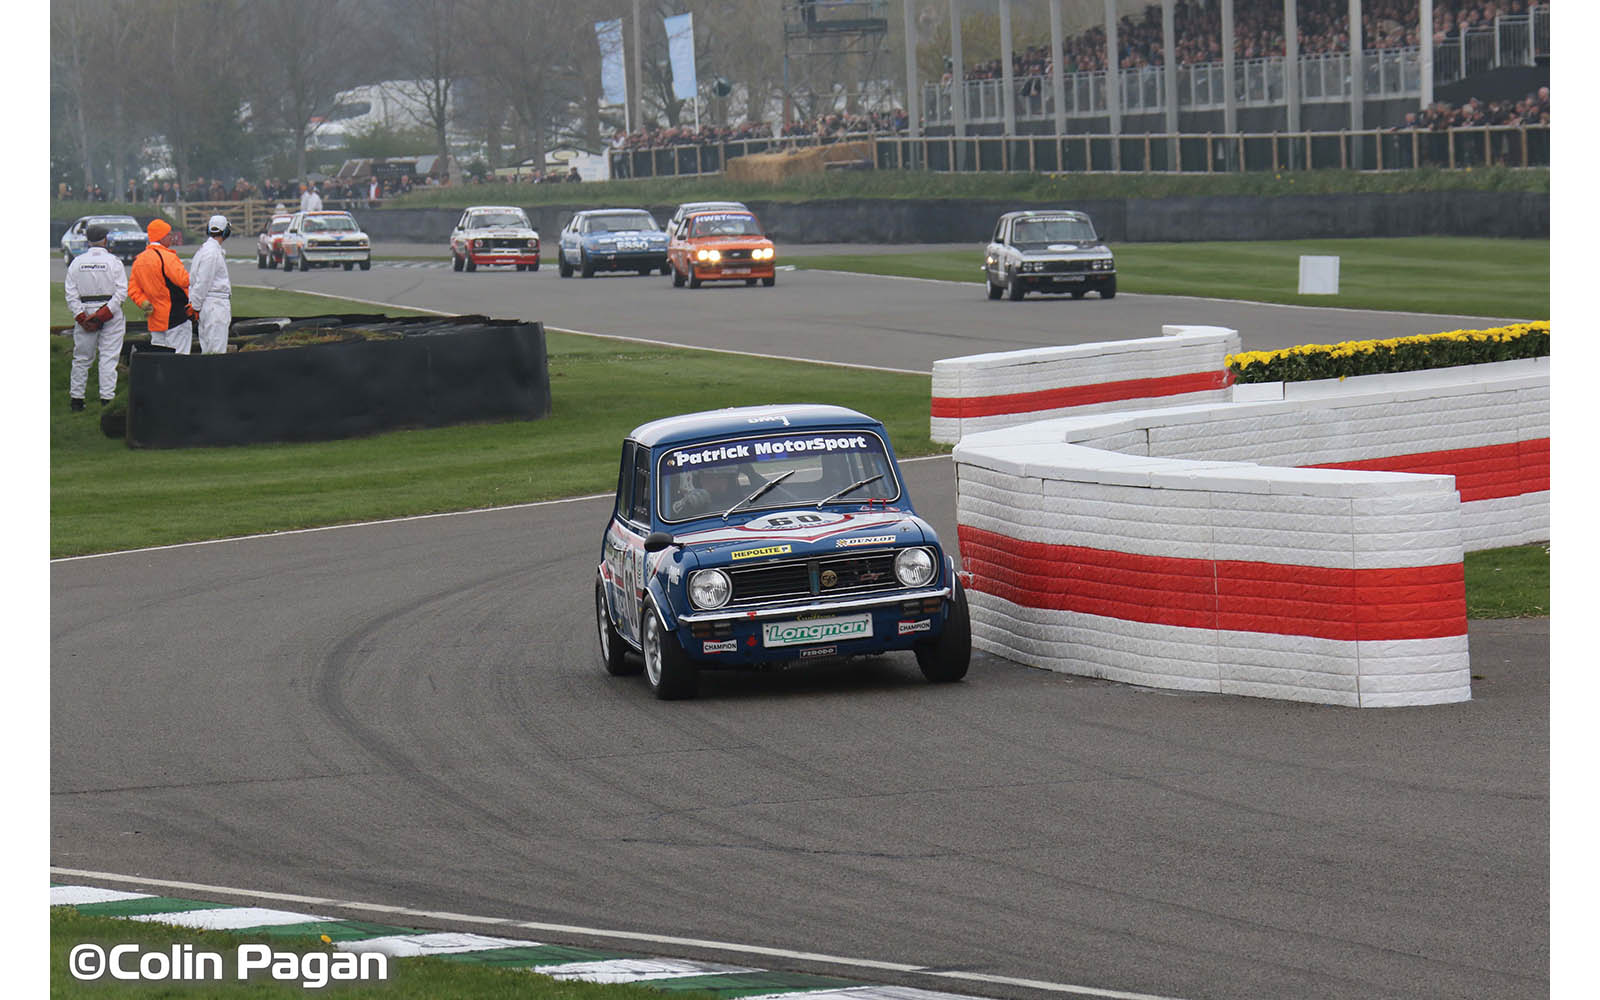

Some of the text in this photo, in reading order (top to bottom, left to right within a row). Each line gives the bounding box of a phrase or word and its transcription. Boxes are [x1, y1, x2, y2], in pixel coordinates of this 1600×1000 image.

[673, 435, 868, 467] Patrick MotorSport
[767, 513, 823, 528] 60
[849, 535, 896, 545] DUNLOP
[733, 546, 780, 559] HEPOLITE
[768, 620, 867, 643] Longman
[899, 622, 931, 632] CHAMPION
[704, 641, 737, 652] CHAMPION
[802, 647, 835, 657] FERODO
